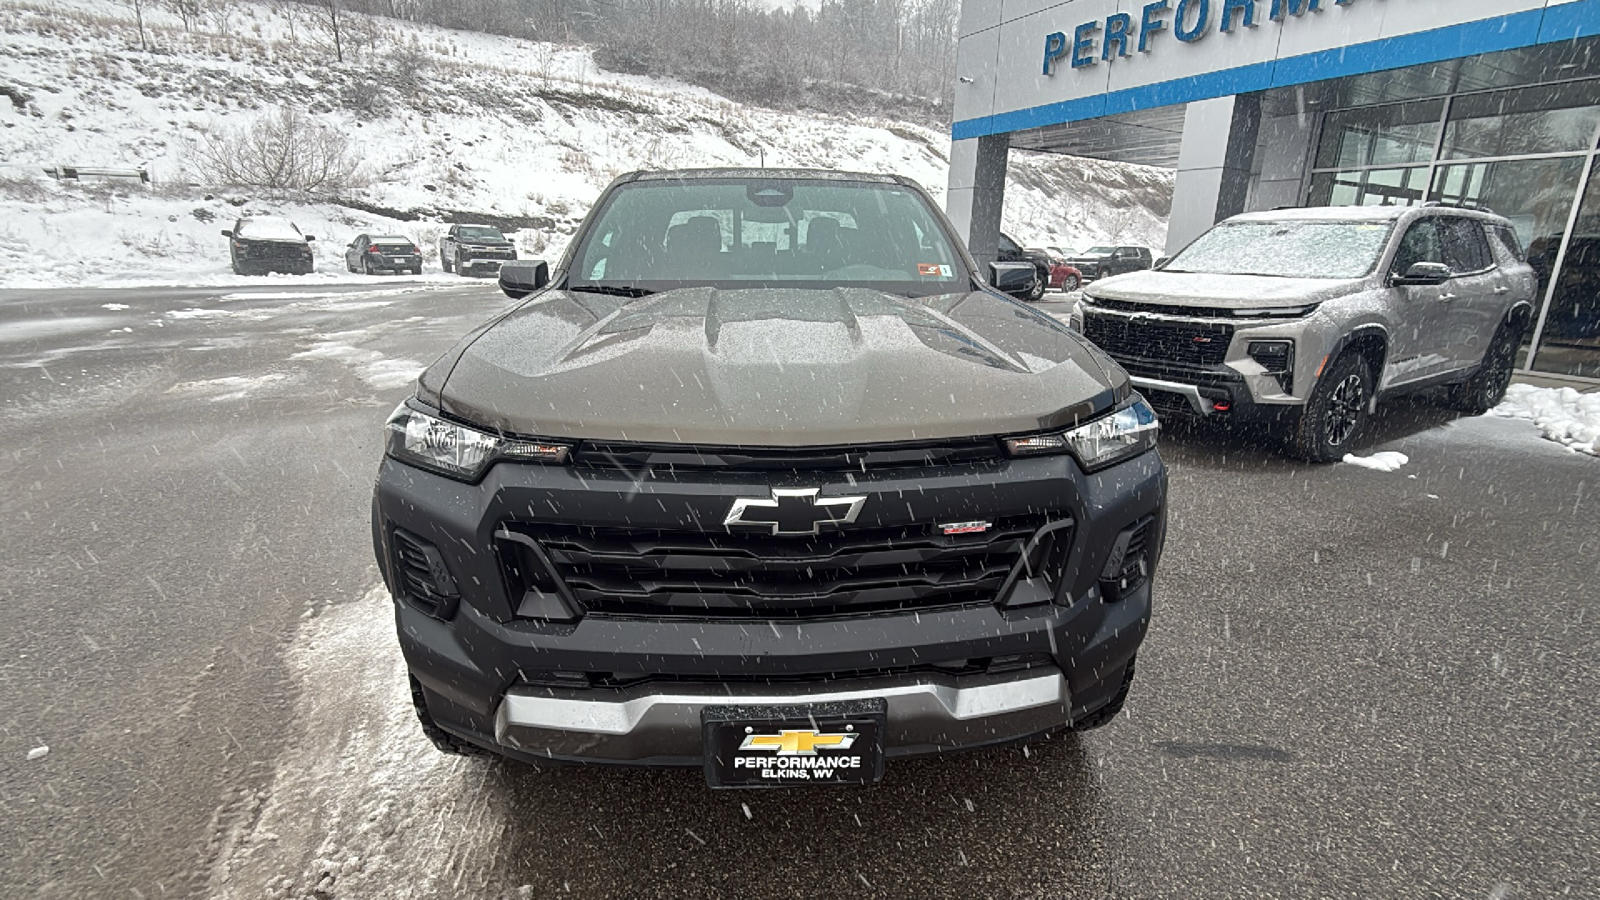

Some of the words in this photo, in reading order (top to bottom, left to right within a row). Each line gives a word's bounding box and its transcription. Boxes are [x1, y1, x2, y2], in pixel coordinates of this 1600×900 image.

[1042, 0, 1353, 76] PERFOR
[734, 756, 861, 769] PERFORMANCE
[761, 769, 810, 780] ELKINS,
[814, 769, 834, 778] WV
